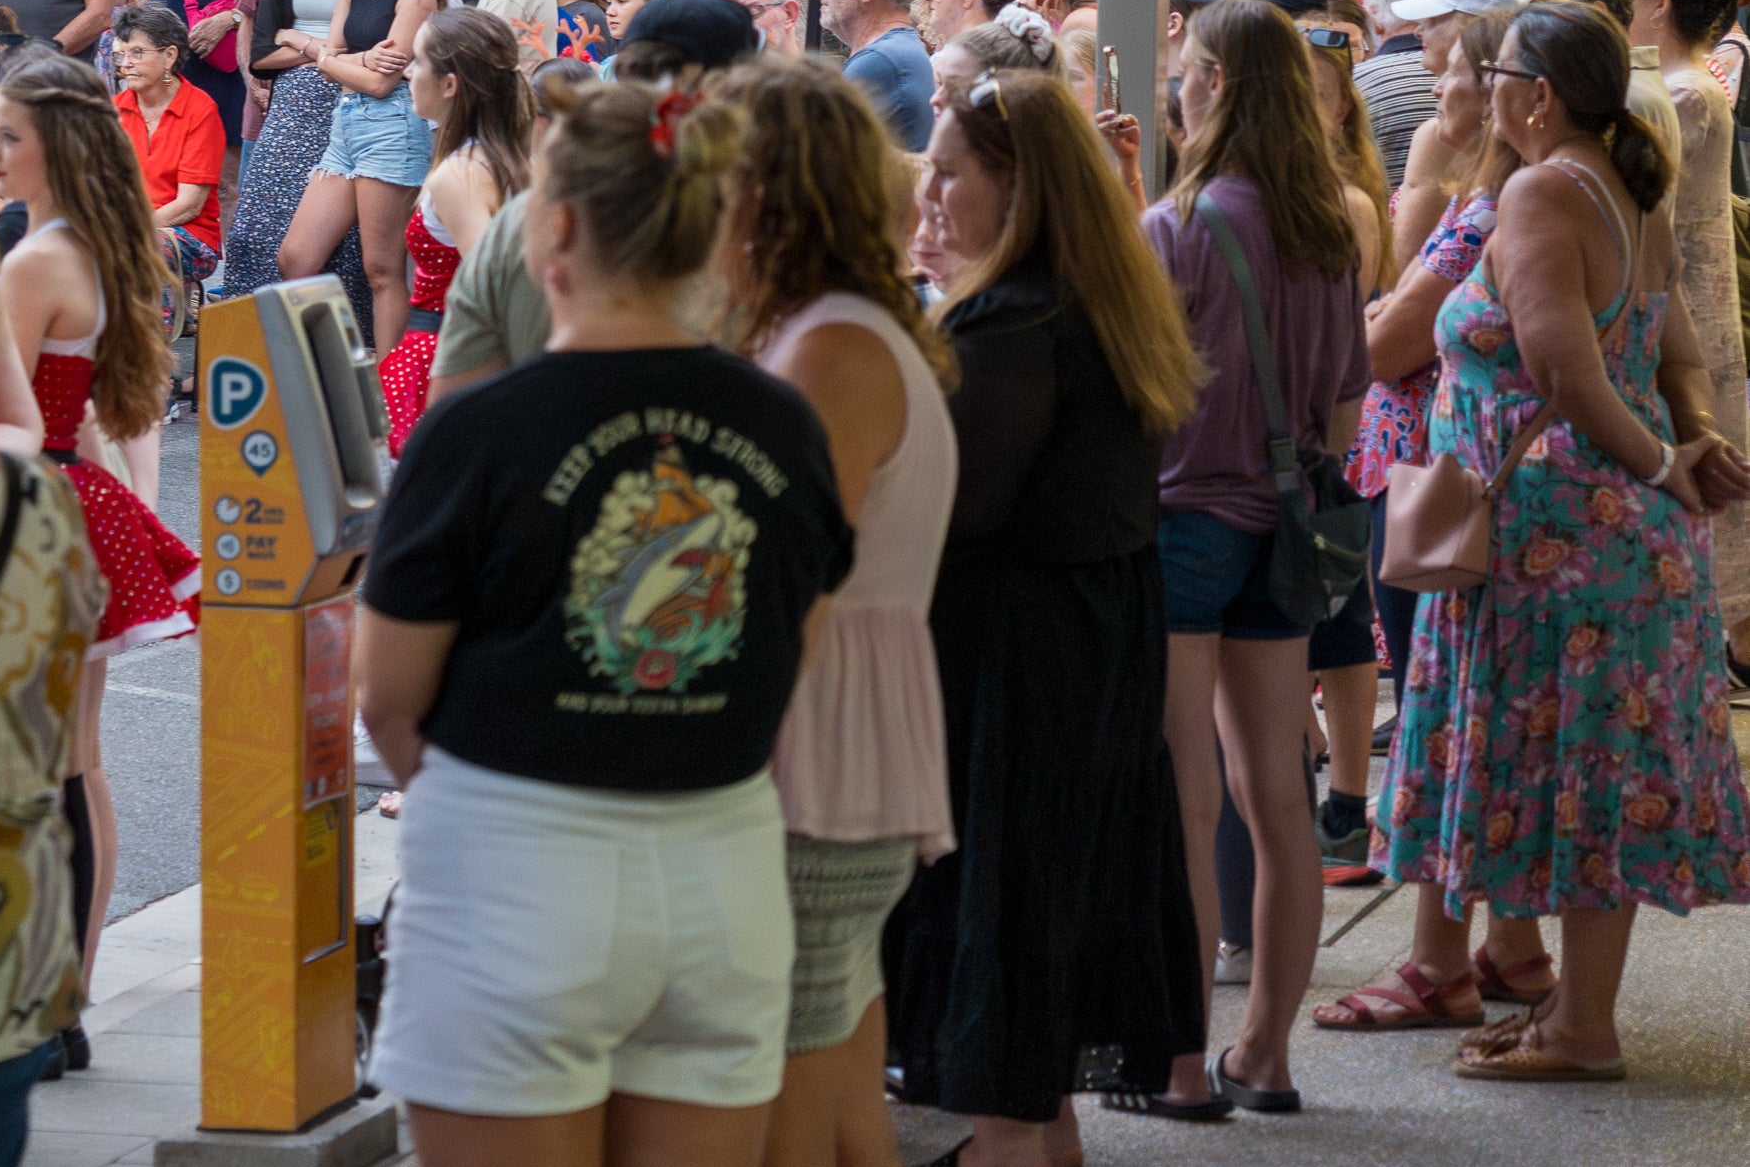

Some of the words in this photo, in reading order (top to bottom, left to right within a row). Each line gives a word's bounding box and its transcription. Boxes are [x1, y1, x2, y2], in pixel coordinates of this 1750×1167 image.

[220, 372, 253, 416] P
[248, 442, 271, 458] 45
[542, 442, 595, 506] KEEP
[586, 410, 641, 457] YOUR
[645, 405, 711, 444] HEAD
[710, 426, 790, 498] STRONG
[245, 498, 262, 524] 2
[246, 535, 277, 547] PAY
